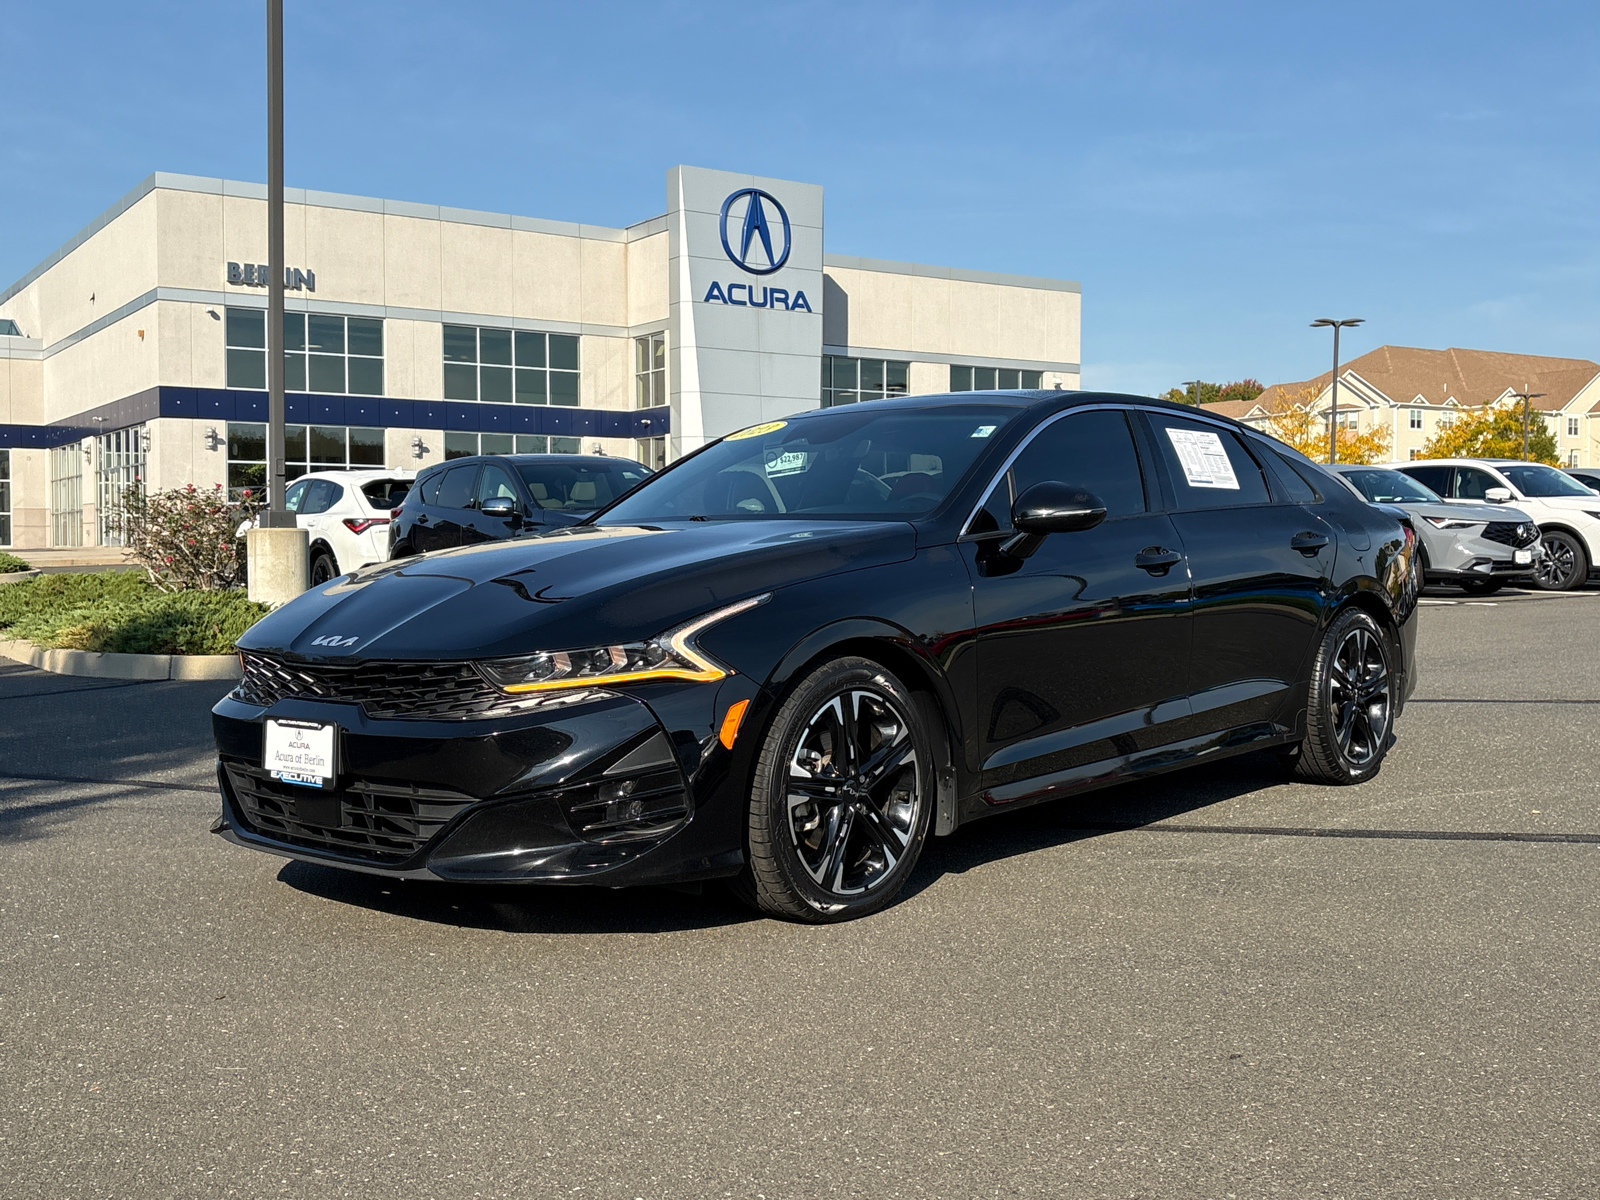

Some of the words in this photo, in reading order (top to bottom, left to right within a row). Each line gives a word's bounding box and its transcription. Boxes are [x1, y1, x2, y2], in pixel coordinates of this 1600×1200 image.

[227, 262, 315, 292] BERIN
[704, 281, 812, 312] ACURA
[780, 453, 804, 464] $22,987
[311, 635, 359, 647] KIA
[288, 741, 311, 750] ACURA
[274, 750, 294, 763] Acura
[295, 754, 303, 764] of
[304, 754, 325, 766] Berlin
[270, 770, 323, 785] EXECUTIVE
